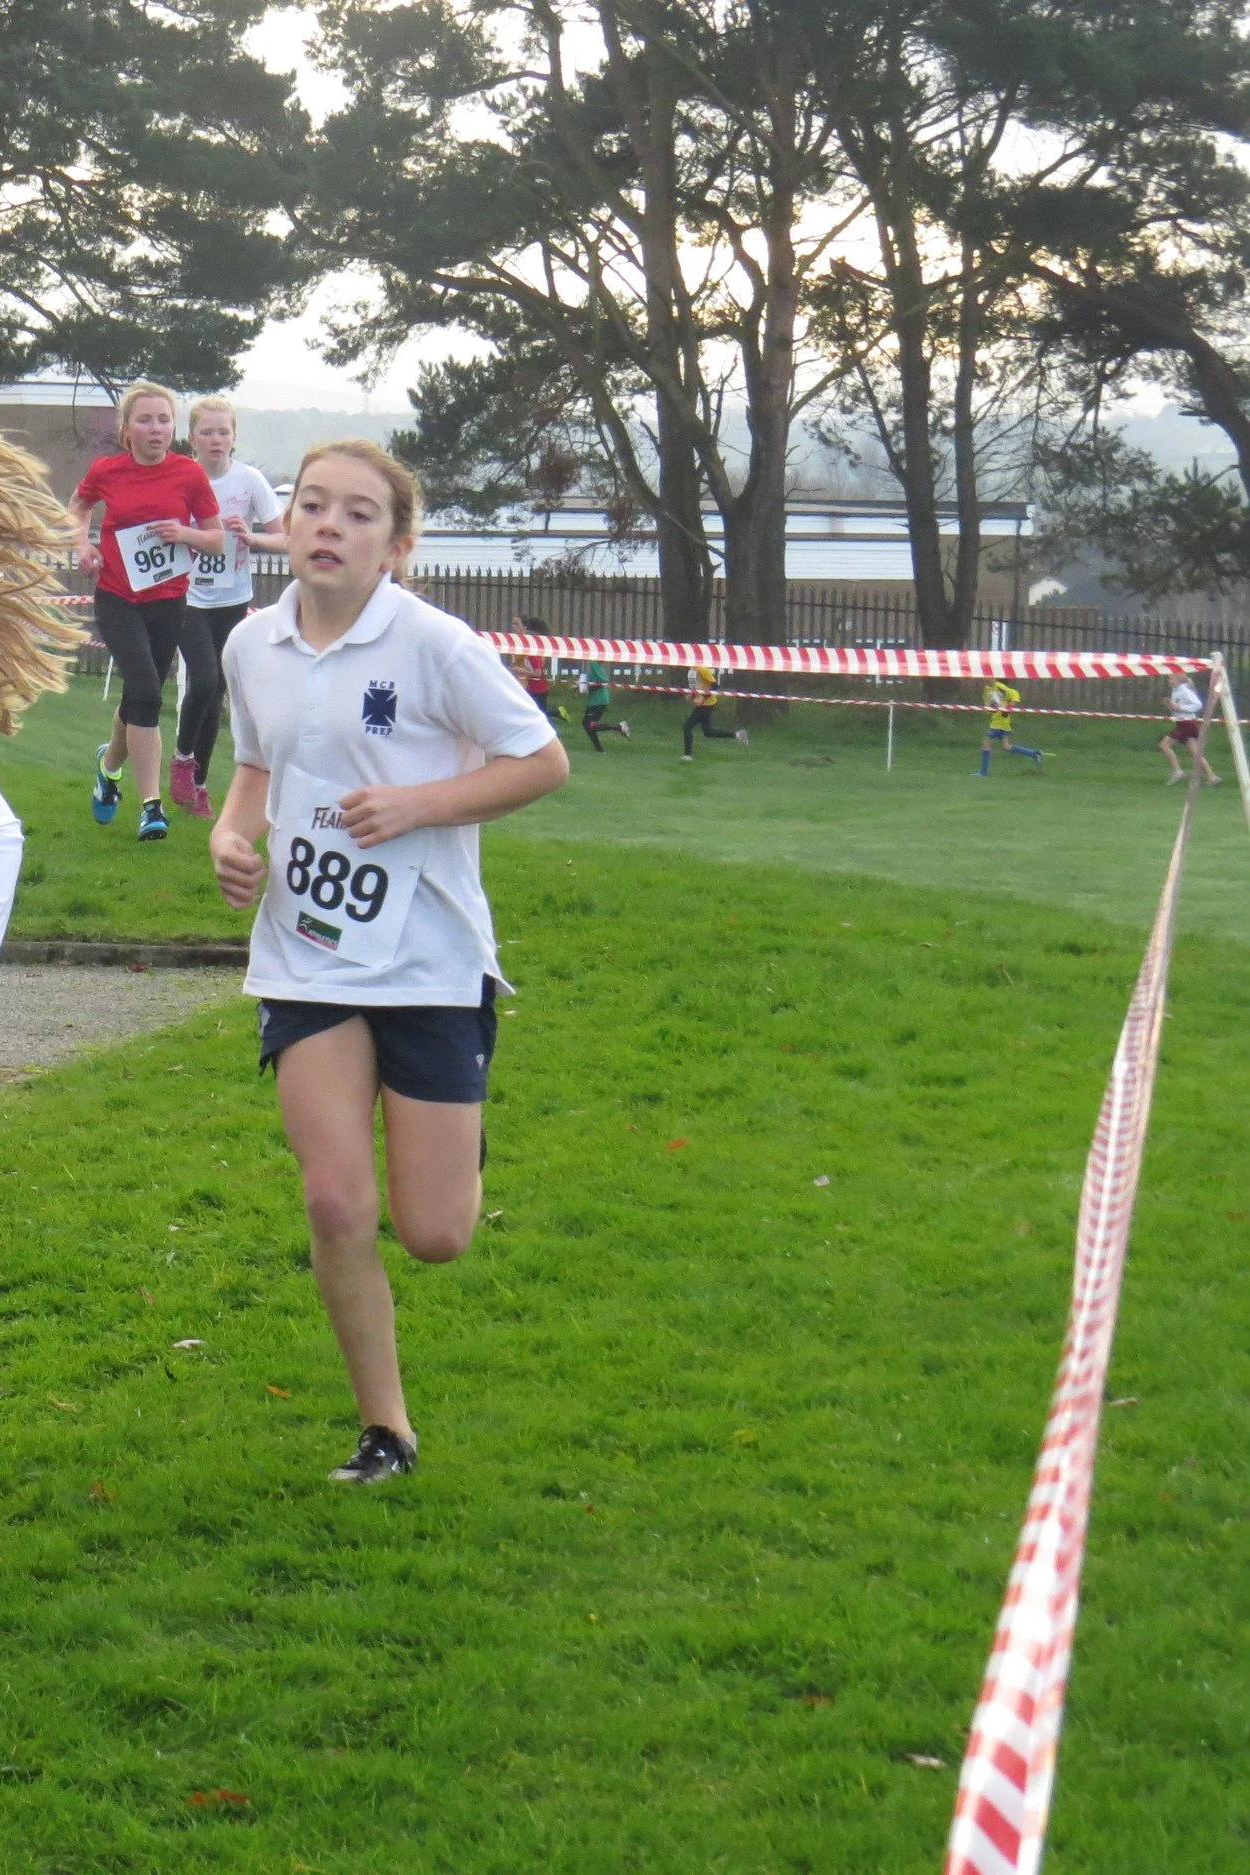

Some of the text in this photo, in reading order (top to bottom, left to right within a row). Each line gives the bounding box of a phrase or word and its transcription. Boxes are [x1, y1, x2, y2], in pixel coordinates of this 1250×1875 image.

[134, 542, 175, 573] 967
[365, 726, 392, 736] PREP
[286, 837, 389, 923] 889
